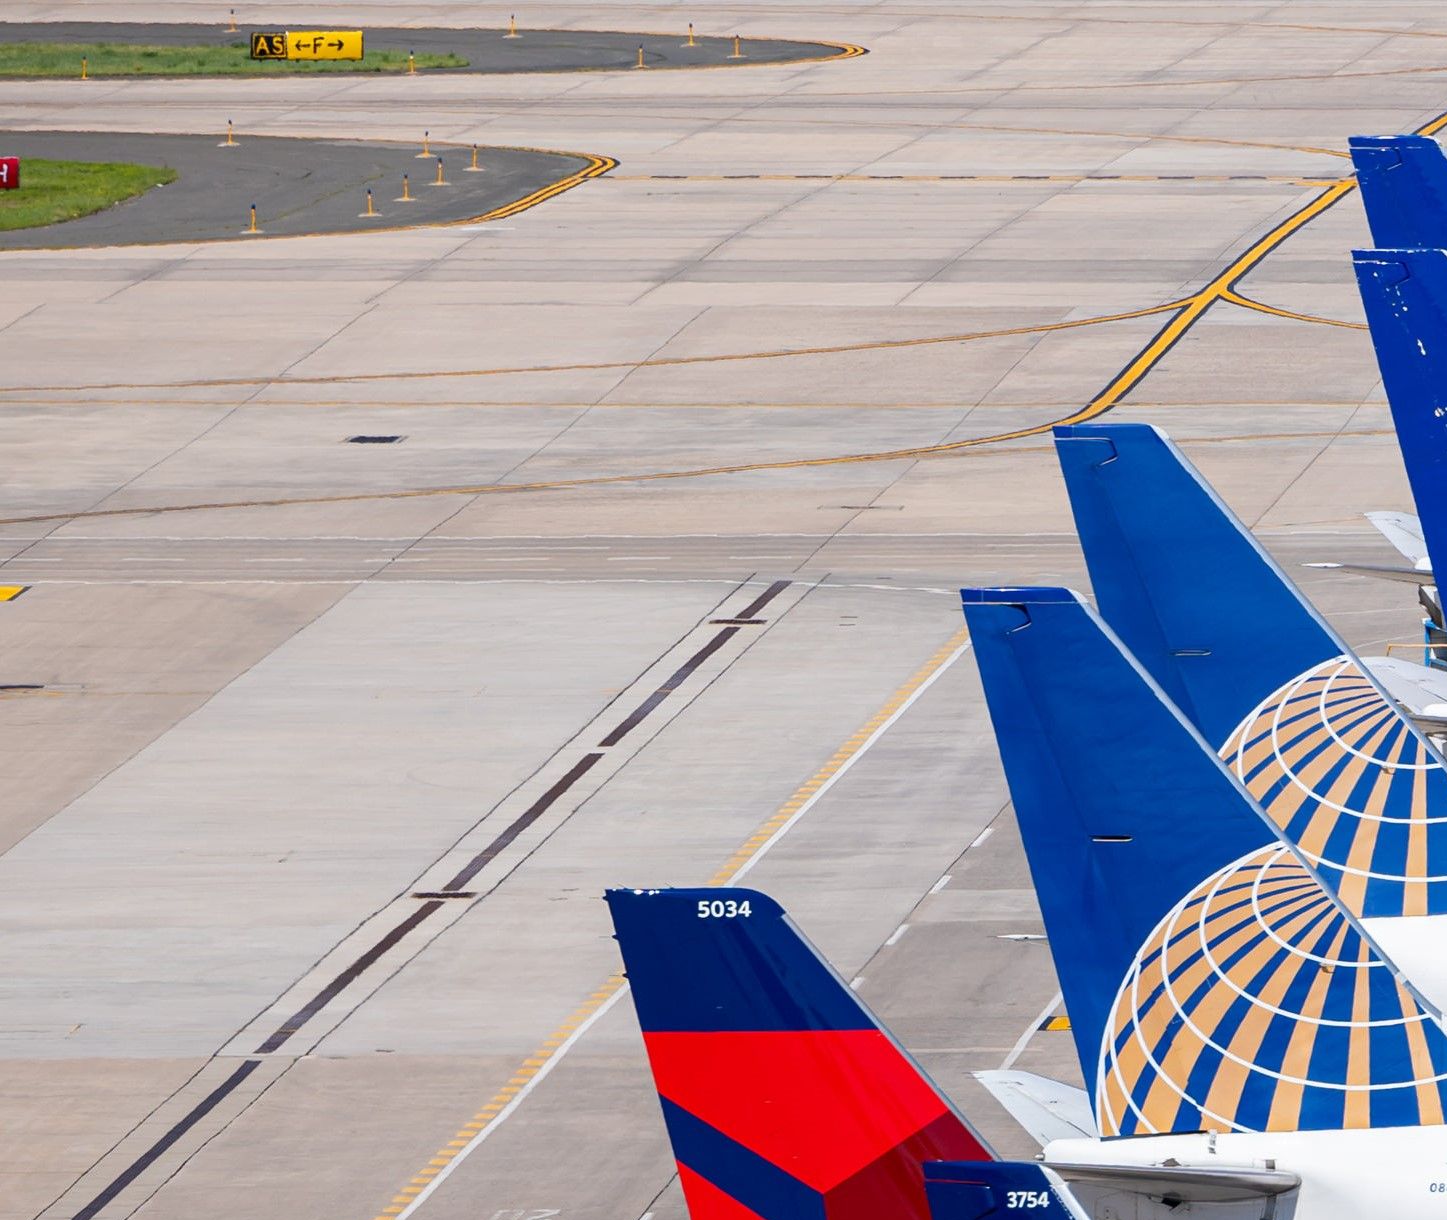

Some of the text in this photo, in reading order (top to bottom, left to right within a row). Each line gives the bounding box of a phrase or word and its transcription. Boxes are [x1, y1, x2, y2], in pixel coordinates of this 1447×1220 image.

[256, 36, 324, 55] AS F
[698, 901, 752, 919] 5034
[1007, 1191, 1050, 1209] 3754
